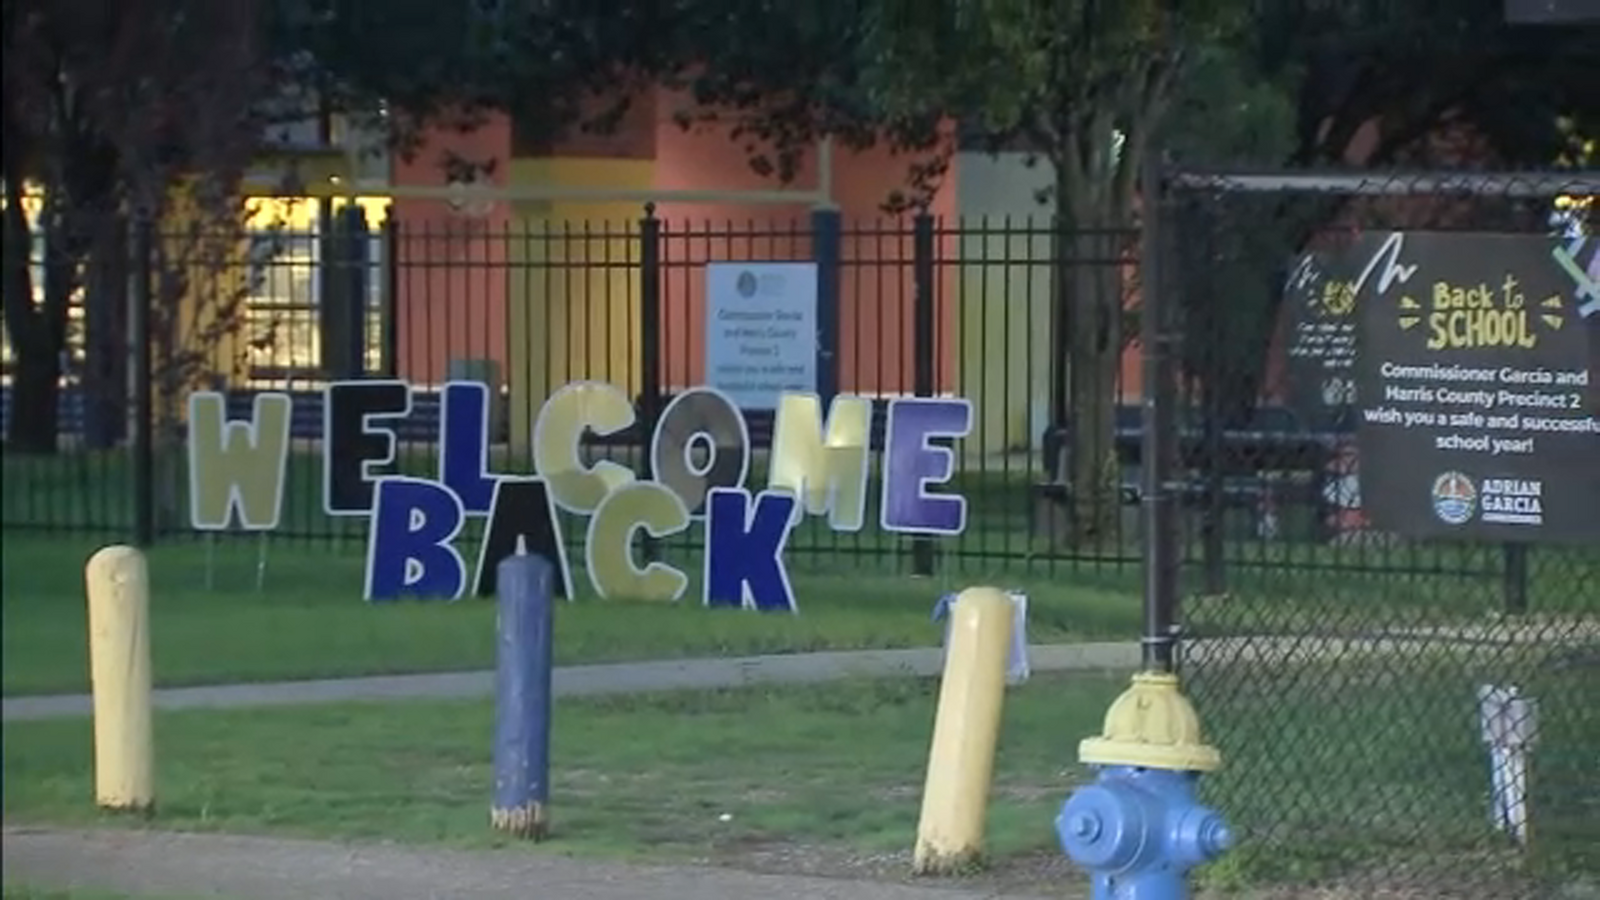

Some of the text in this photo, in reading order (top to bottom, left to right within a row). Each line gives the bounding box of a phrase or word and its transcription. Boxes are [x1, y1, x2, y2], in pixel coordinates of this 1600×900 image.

[1432, 273, 1524, 310] Back to
[1427, 309, 1537, 350] SCHOOL
[1381, 362, 1588, 385] Commissioner Garcia and
[1386, 385, 1581, 409] Harris County Precinct 2
[1364, 407, 1402, 424] wish
[1404, 412, 1434, 428] you
[1437, 413, 1447, 425] a
[1450, 411, 1484, 427] safe
[1487, 413, 1519, 430] and
[1436, 434, 1534, 455] school year!
[188, 379, 973, 535] WELCOME
[1482, 479, 1542, 497] ADRIAN
[1481, 495, 1542, 513] GARCIA
[364, 475, 798, 614] BACK
